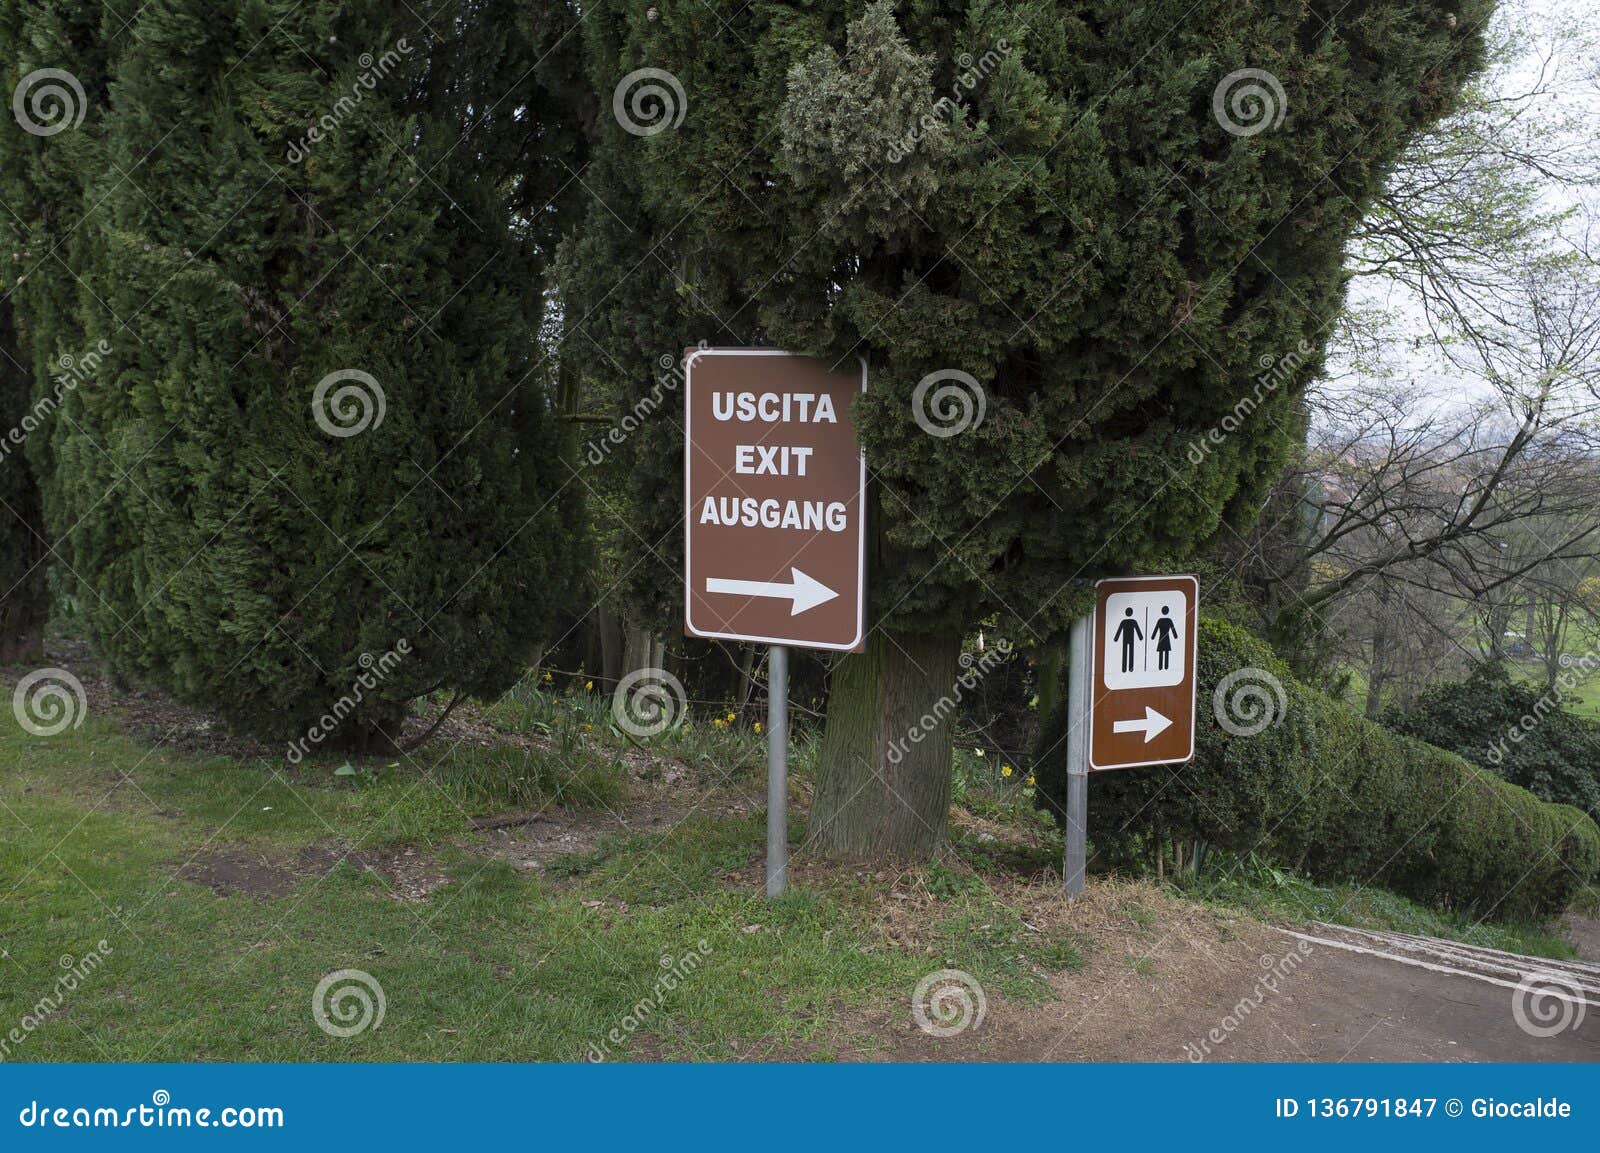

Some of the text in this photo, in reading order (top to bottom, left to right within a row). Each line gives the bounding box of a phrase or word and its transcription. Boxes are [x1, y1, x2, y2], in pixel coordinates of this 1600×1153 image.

[712, 391, 837, 423] USCITA
[735, 444, 813, 477] EXIT
[699, 496, 847, 532] AUSGANG
